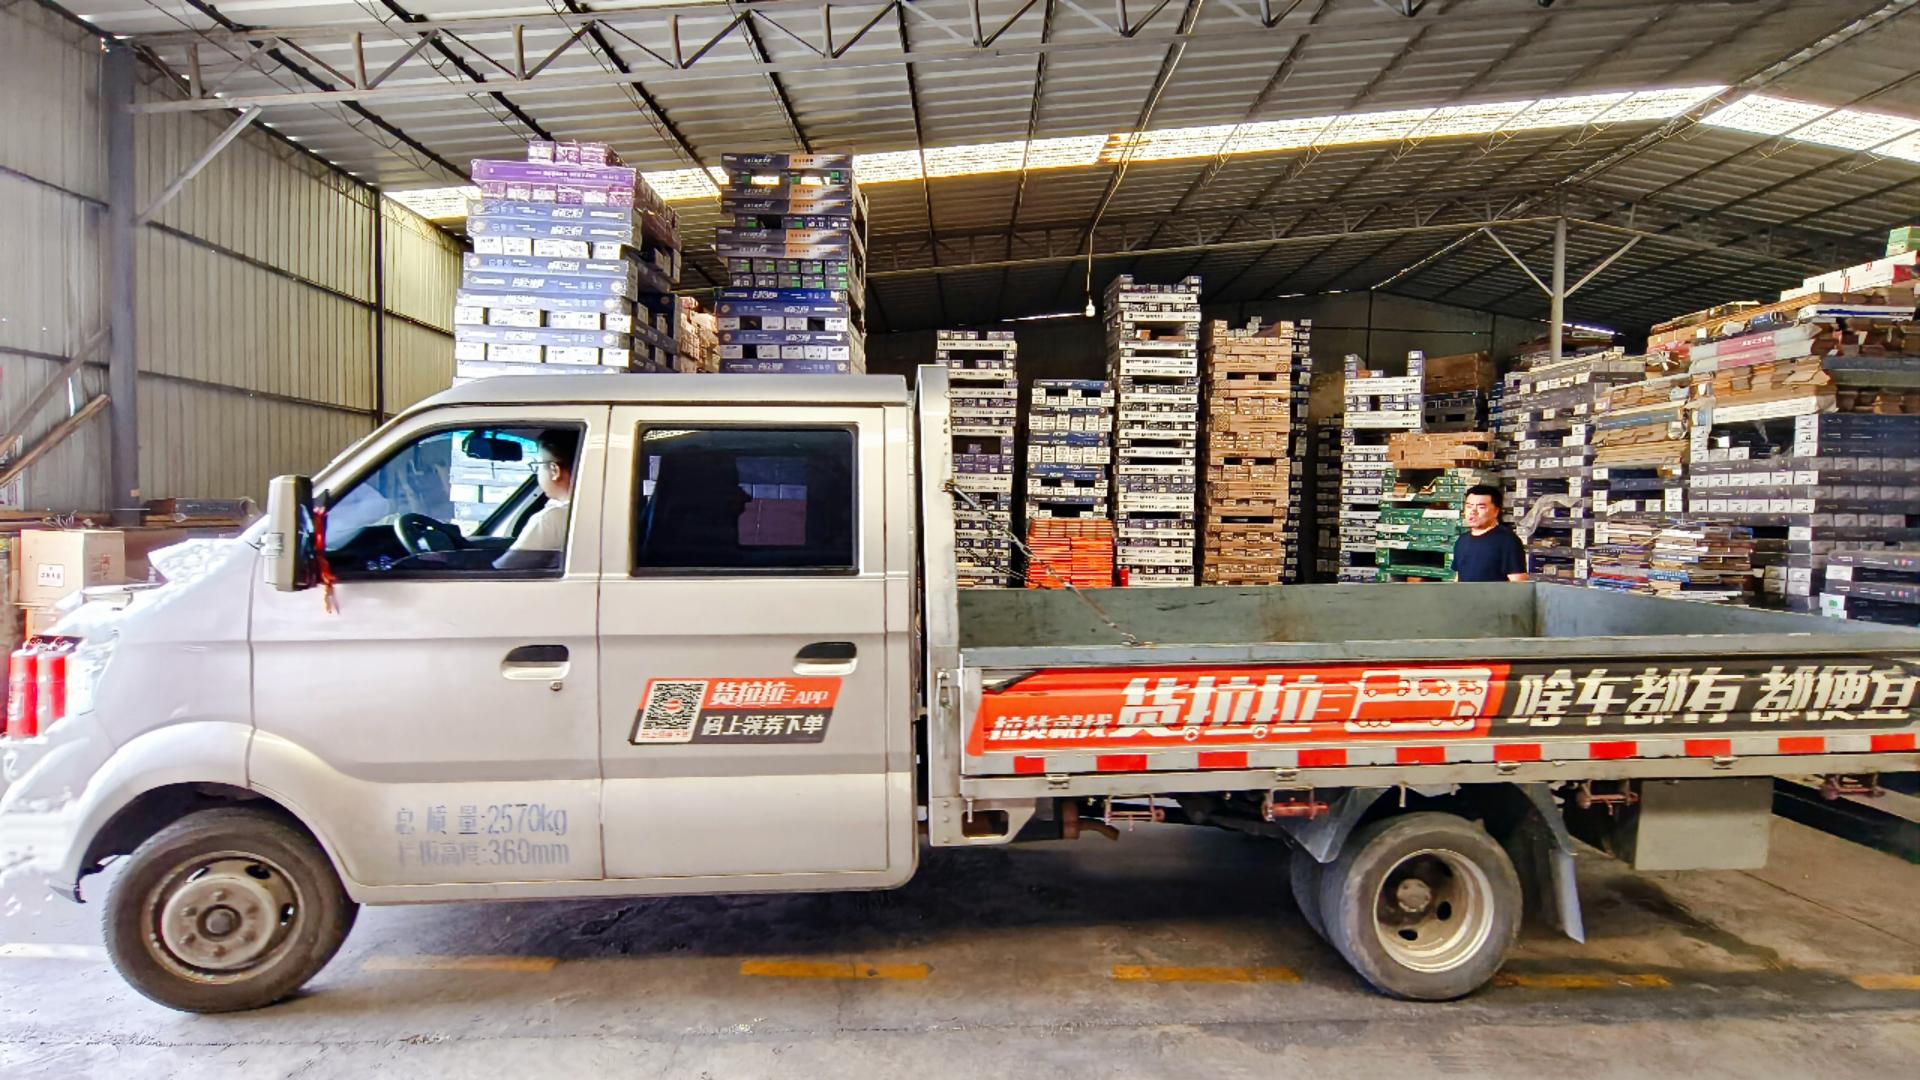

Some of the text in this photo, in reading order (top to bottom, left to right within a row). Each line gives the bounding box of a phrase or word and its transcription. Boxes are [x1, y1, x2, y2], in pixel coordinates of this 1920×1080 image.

[709, 681, 829, 706] 货拉拉 APP
[989, 664, 1919, 741] 拉货就找 货拉拉 啥车都有 都便宜
[701, 714, 825, 736] 码上领券下单
